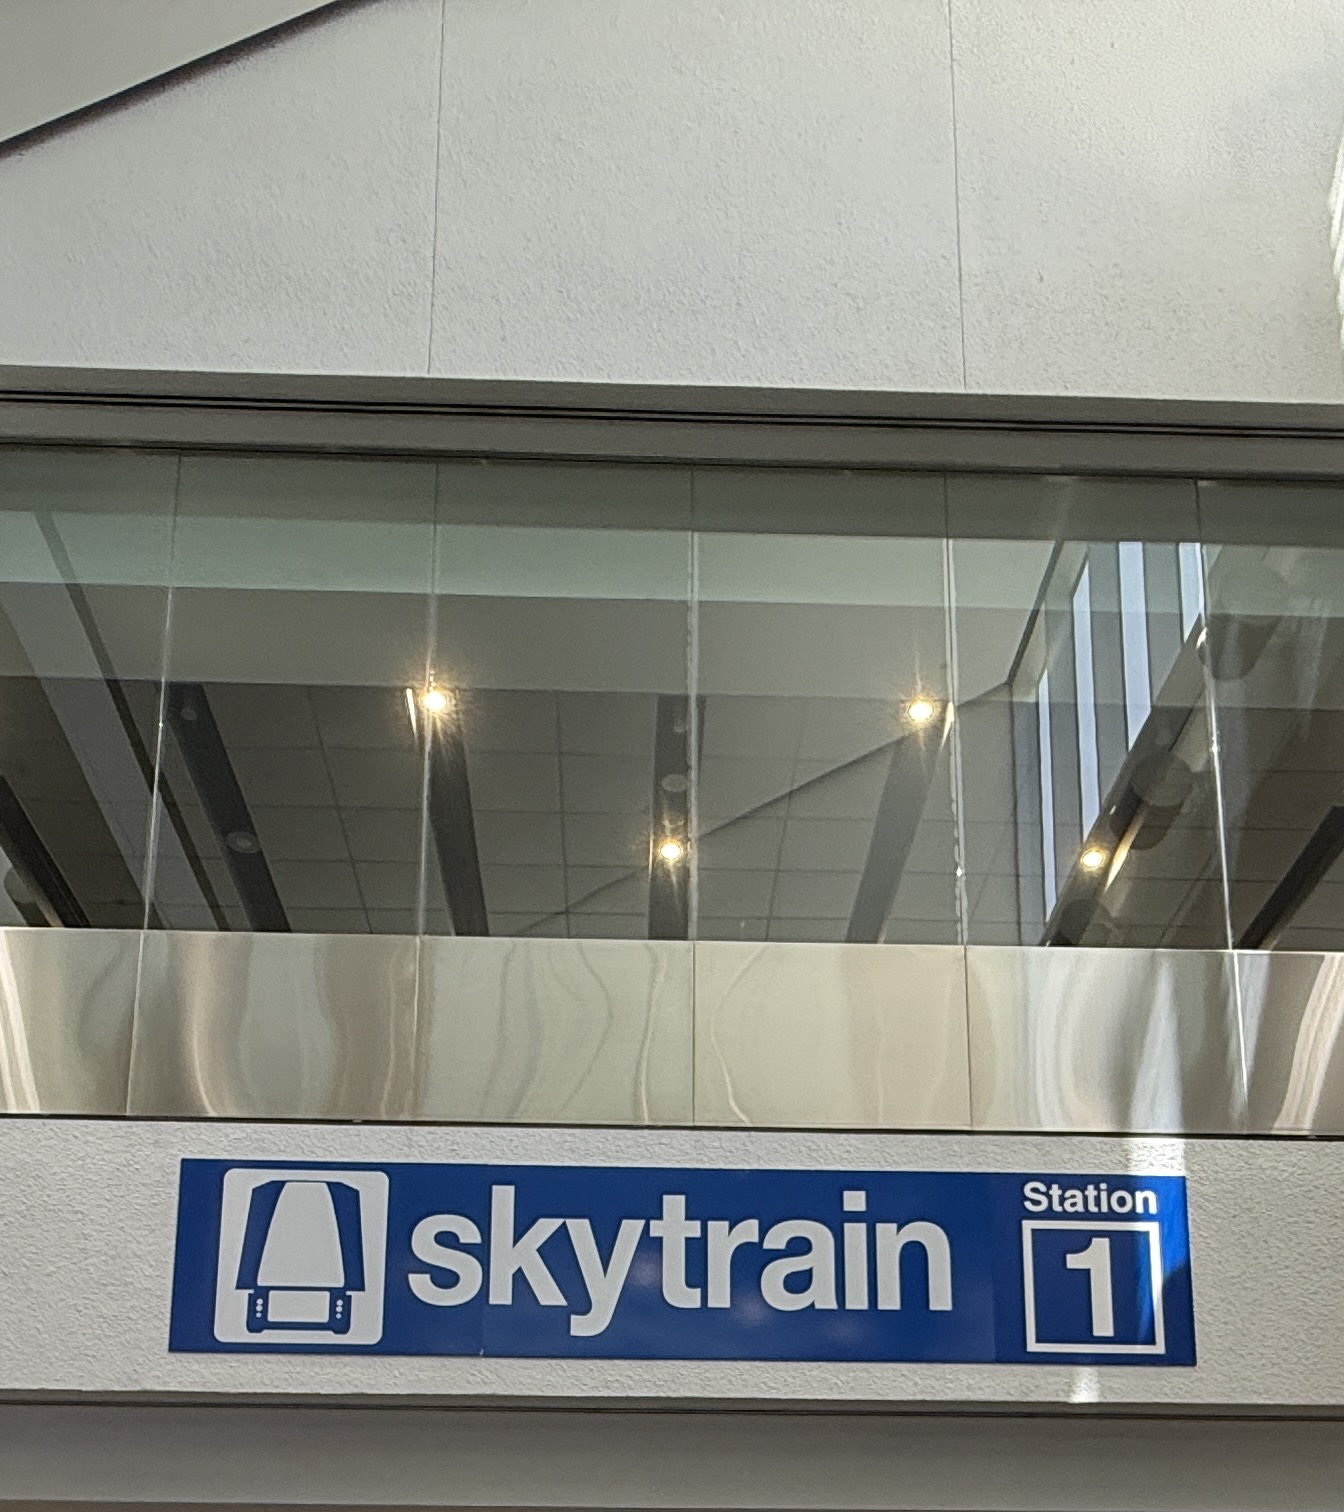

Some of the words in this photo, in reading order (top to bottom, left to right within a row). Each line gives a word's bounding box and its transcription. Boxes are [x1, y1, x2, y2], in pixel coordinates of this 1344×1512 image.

[1022, 1181, 1159, 1214] Station
[407, 1184, 953, 1337] skytrain
[1065, 1236, 1115, 1338] 1
